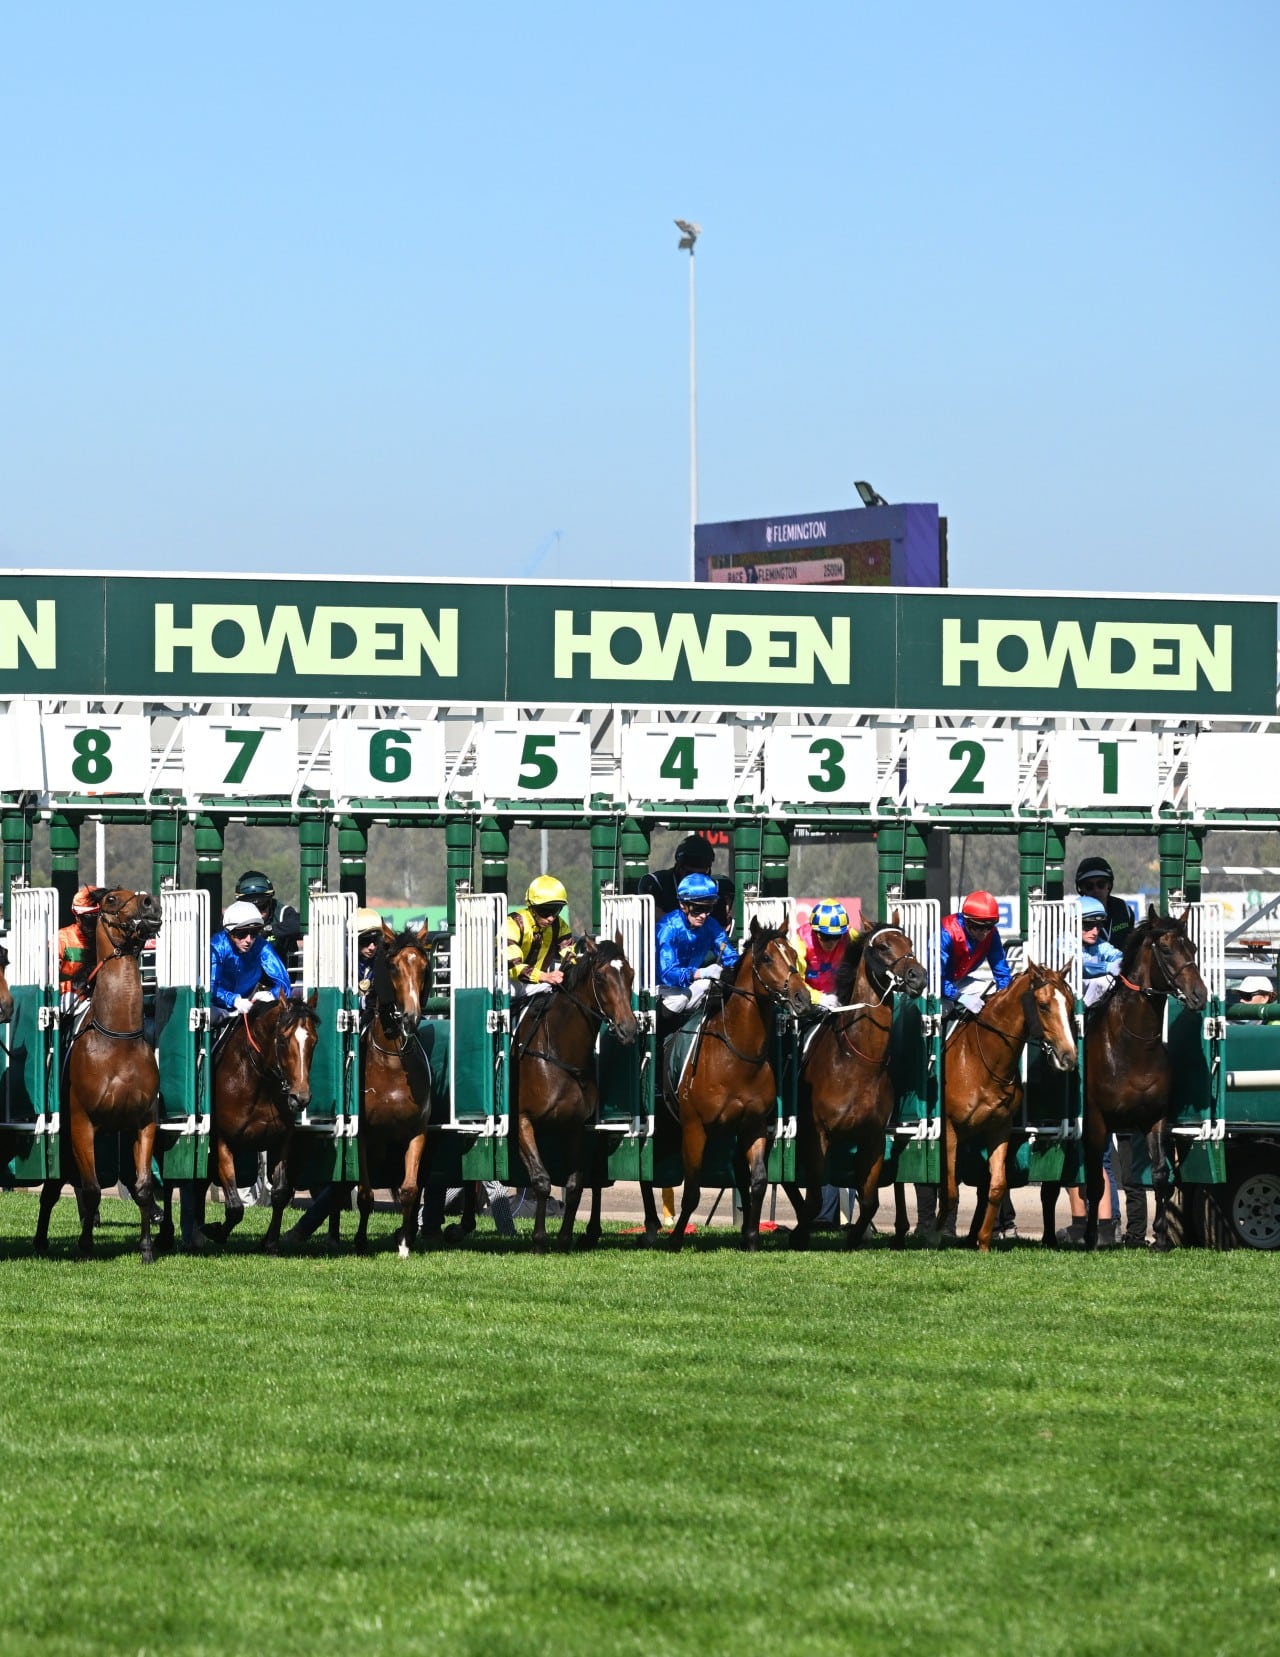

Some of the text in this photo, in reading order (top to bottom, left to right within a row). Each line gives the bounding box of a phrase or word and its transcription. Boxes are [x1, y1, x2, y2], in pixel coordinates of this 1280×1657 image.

[773, 520, 827, 543] FLEMINGTON
[757, 566, 798, 582] FLEMINGTON
[155, 604, 458, 676] HOWDEN
[555, 611, 850, 684] HOWDEN
[943, 619, 1231, 691] HOWDEN
[73, 729, 111, 784] 8
[224, 730, 262, 783] 7
[370, 729, 412, 783] 6
[520, 734, 557, 790] 5
[660, 736, 698, 789] 4
[808, 739, 846, 792] 3
[950, 740, 985, 794] 2
[1098, 743, 1117, 794] 1
